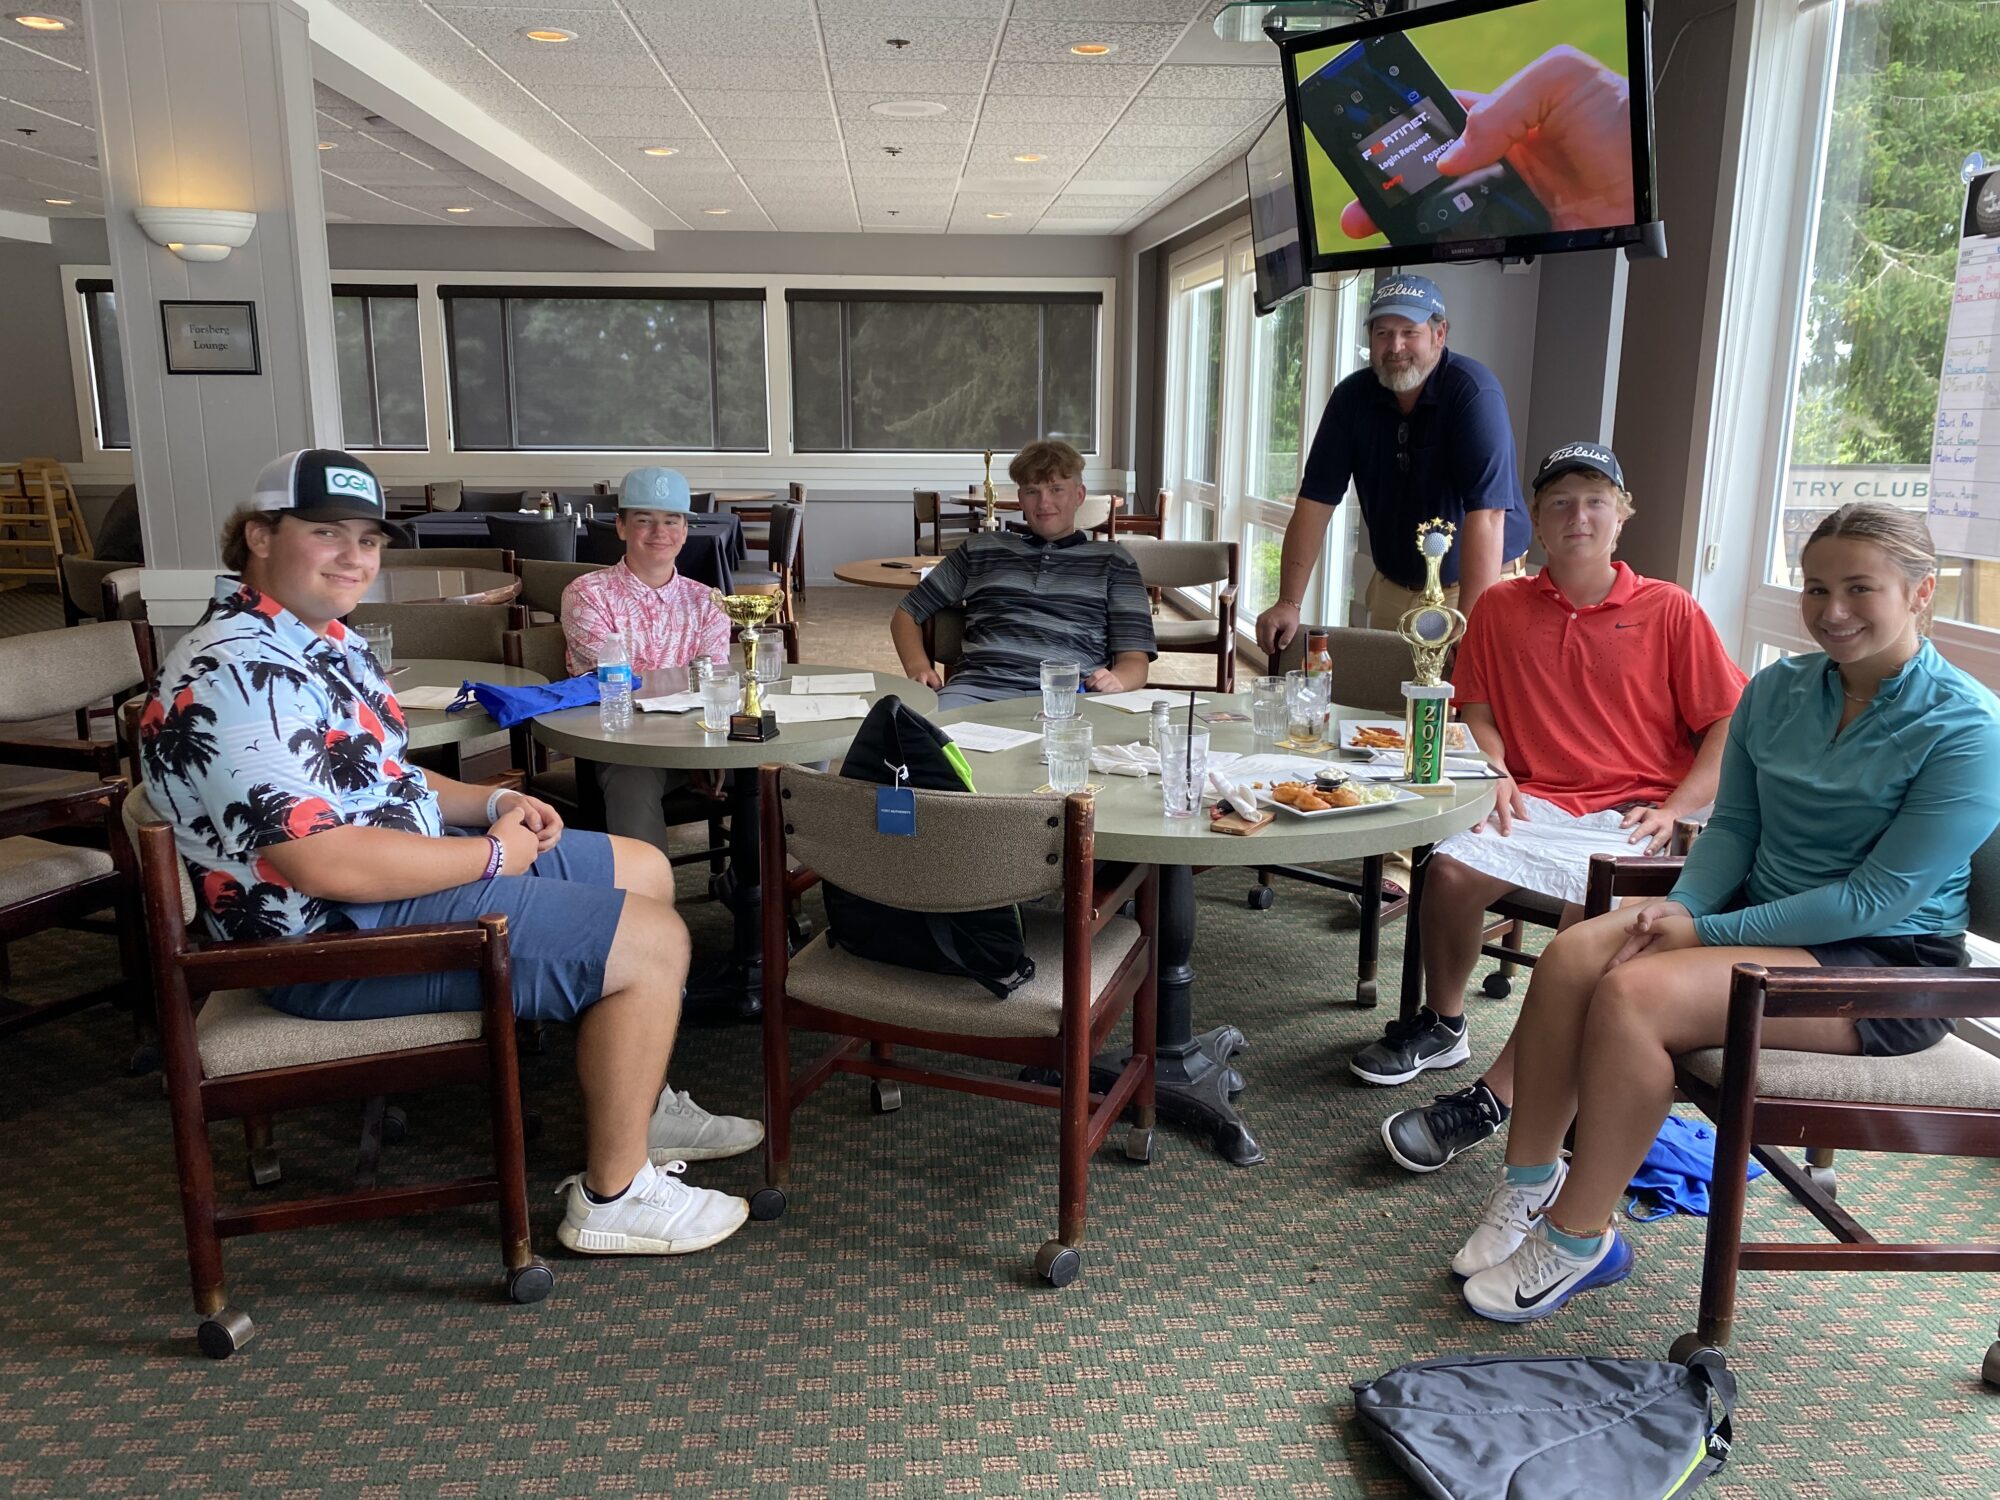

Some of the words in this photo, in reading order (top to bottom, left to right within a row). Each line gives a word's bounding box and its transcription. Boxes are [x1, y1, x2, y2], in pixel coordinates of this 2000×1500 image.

[1378, 154, 1401, 170] Login
[1398, 132, 1432, 157] Request
[1372, 282, 1426, 304] Titleist
[189, 324, 230, 335] Forsberg
[193, 340, 229, 351] Lounge
[1543, 446, 1611, 470] Titleist
[1853, 481, 1929, 498] CLUB
[1420, 705, 1437, 778] 2022
